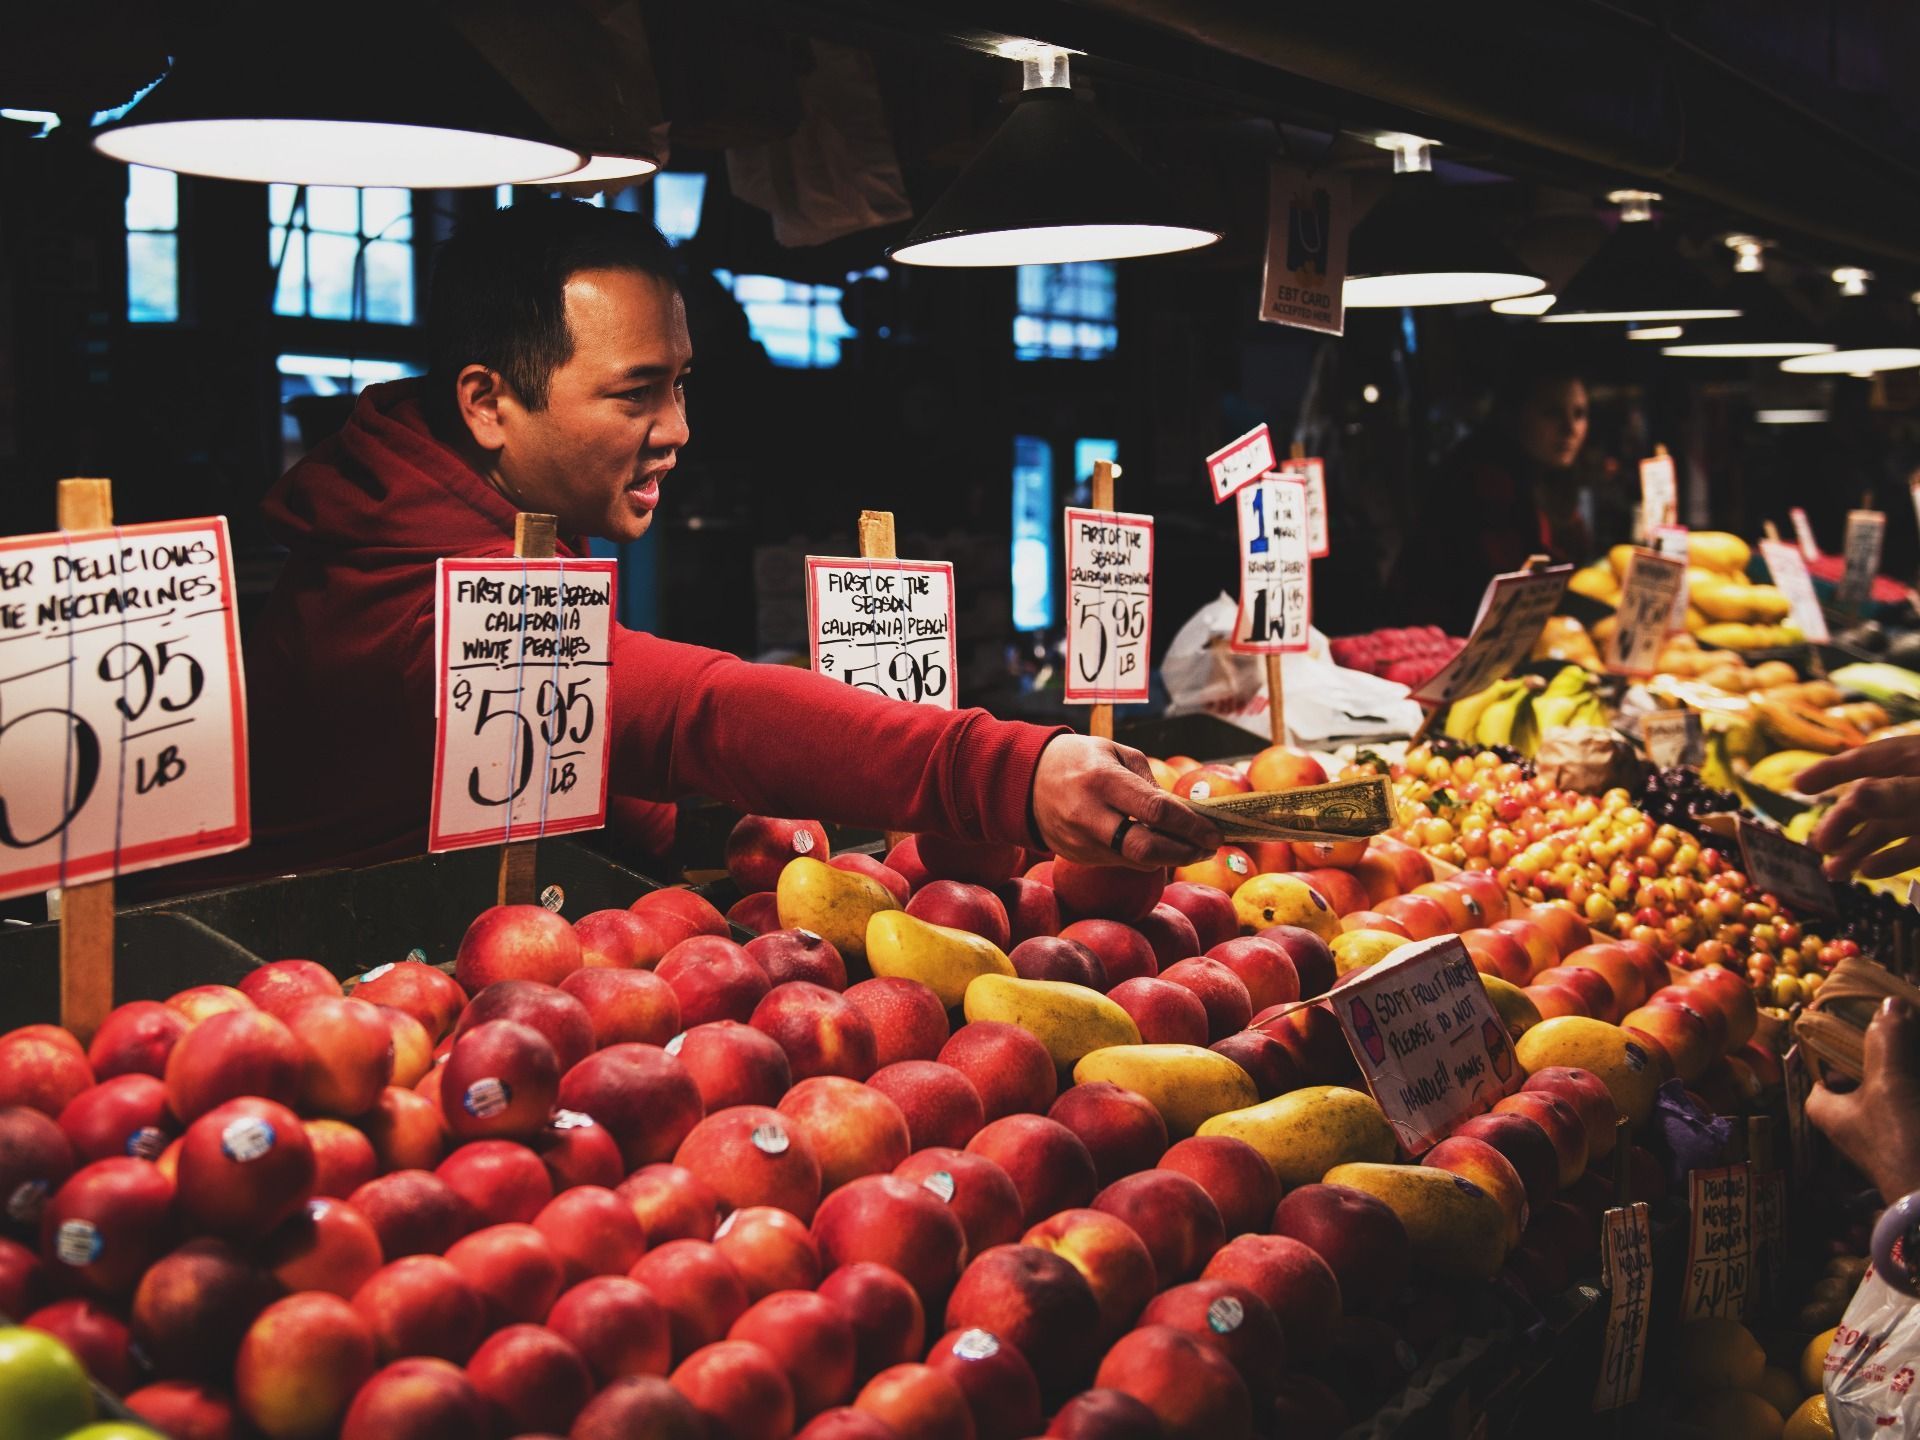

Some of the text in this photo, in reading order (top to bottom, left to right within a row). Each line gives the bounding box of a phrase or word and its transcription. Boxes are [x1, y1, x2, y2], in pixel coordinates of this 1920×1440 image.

[1279, 285, 1331, 308] EBT CARD
[1109, 527, 1121, 545] OF
[1125, 530, 1141, 549] THE
[53, 541, 215, 583] DELICIOUS
[1091, 548, 1131, 569] SEASON
[457, 577, 610, 607] FIRST OF THE SEASON
[829, 572, 930, 595] FIRST OF THE
[37, 576, 216, 626] NECTARINES
[852, 593, 912, 615] SEASON
[485, 608, 580, 632] CALIFORNIA
[821, 613, 948, 637] CALIFORNIA PEACH
[463, 635, 591, 661] WHITE PEACHES
[1119, 653, 1136, 676] LB
[136, 745, 187, 795] LB
[550, 762, 577, 795] LB
[1376, 990, 1412, 1025] SOFT
[1411, 972, 1446, 1006] FRUIT
[1388, 994, 1476, 1060] PLEASE DO NOT
